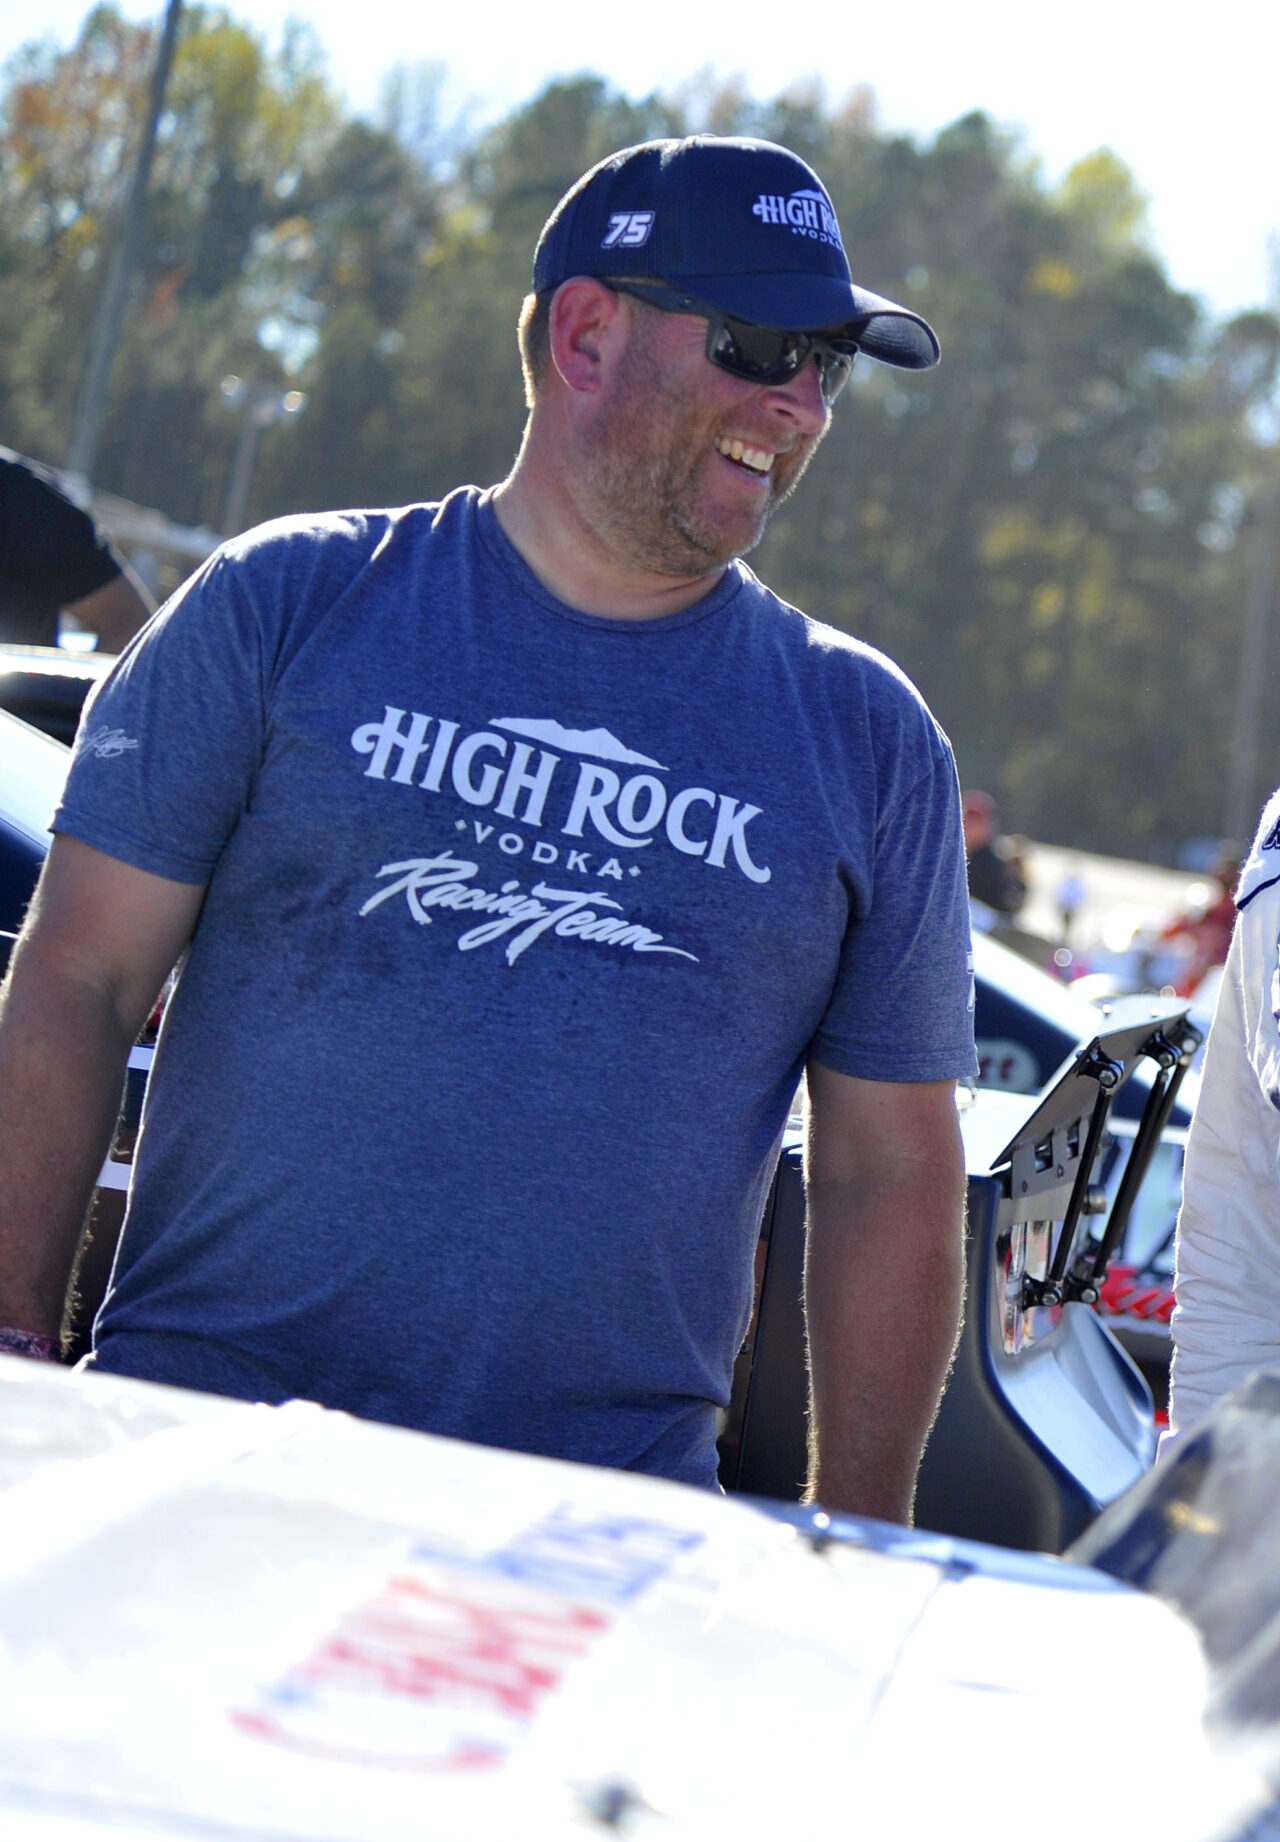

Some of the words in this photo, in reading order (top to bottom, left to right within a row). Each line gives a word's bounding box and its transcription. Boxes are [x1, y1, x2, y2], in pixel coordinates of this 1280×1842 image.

[602, 212, 654, 247] 75
[752, 194, 819, 230] HIGH
[350, 705, 561, 827] HIGH
[561, 762, 771, 884] ROCK
[473, 820, 624, 880] VODKA
[358, 850, 552, 951] Racing
[505, 881, 700, 967] Team
